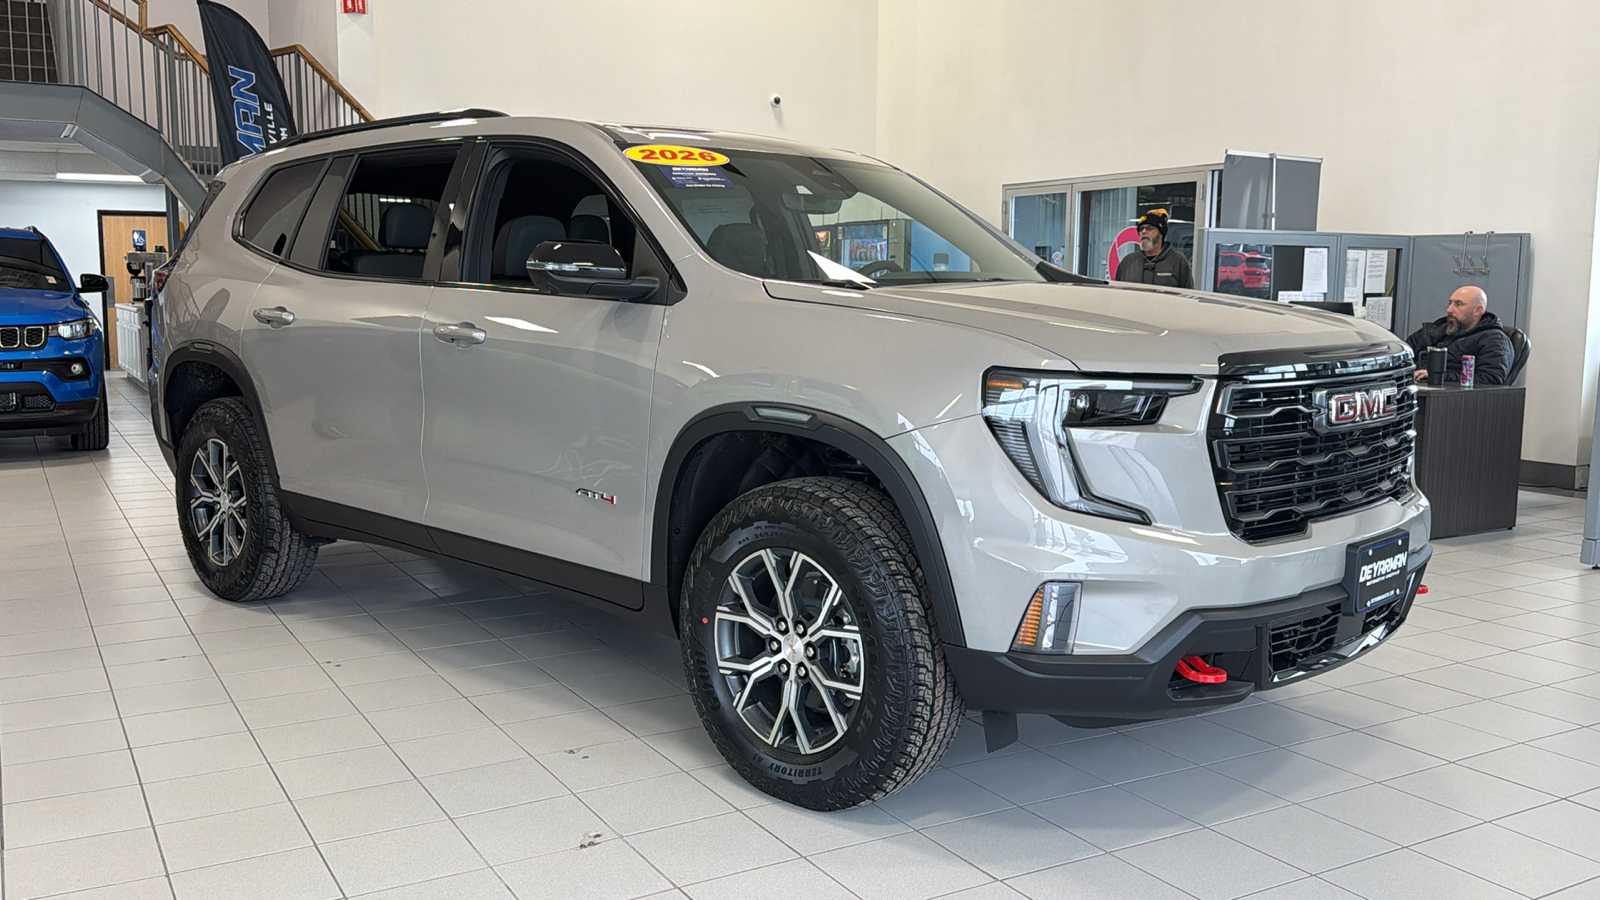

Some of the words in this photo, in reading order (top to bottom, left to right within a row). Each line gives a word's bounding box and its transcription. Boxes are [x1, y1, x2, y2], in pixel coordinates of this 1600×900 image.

[638, 149, 718, 162] 2026
[1331, 386, 1397, 424] GMC
[575, 487, 616, 506] AT4
[1358, 551, 1408, 583] DEYARMAN
[767, 762, 823, 778] TERRITORY
